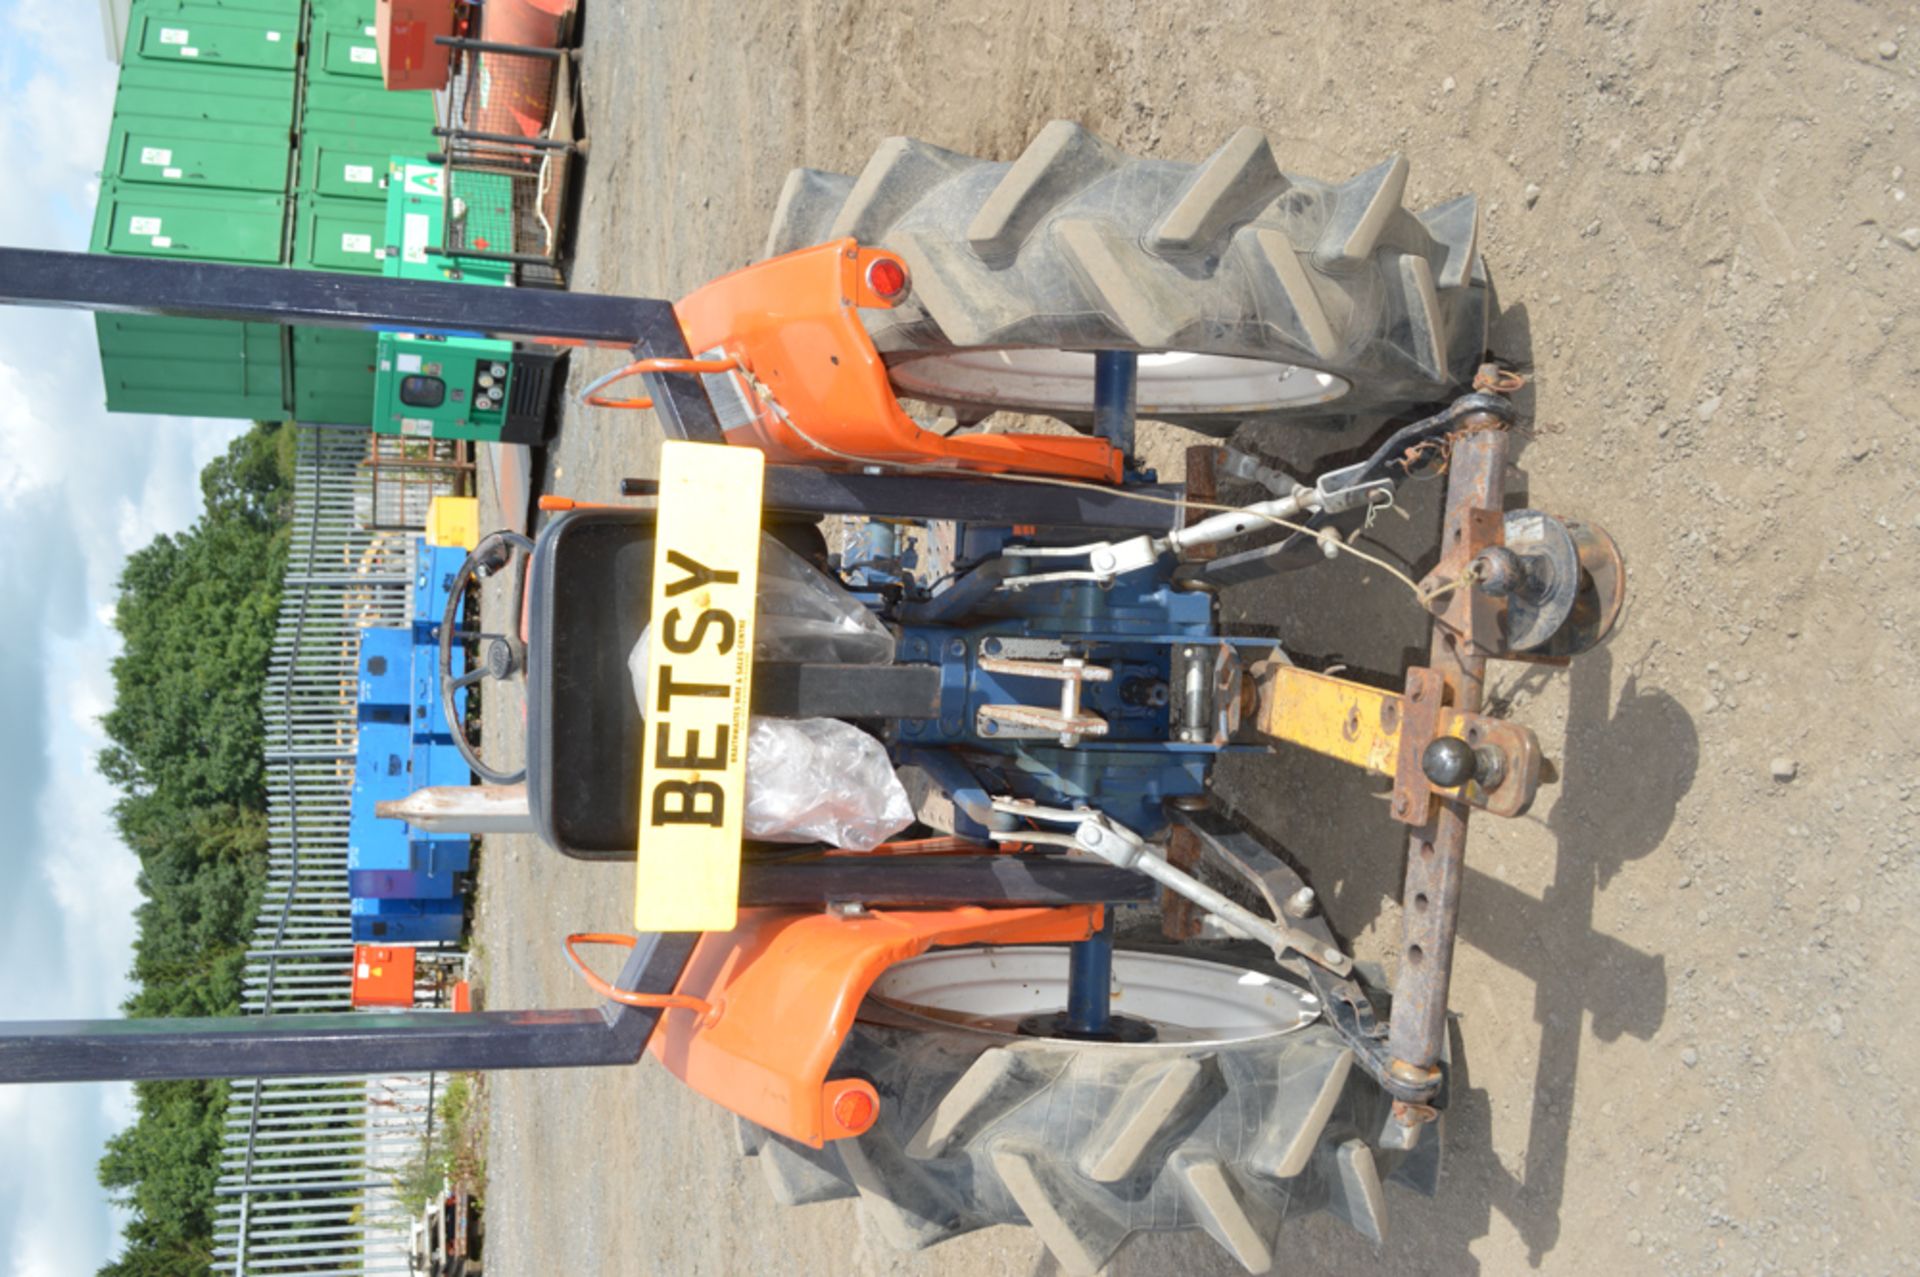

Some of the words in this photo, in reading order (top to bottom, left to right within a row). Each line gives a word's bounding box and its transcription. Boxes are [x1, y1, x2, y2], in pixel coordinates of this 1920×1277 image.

[738, 620, 746, 648] CENTRE
[736, 651, 744, 675] SALES
[651, 550, 740, 828] BETSY
[733, 686, 742, 704] HIRE
[730, 706, 741, 763] BRAITHWAITES
